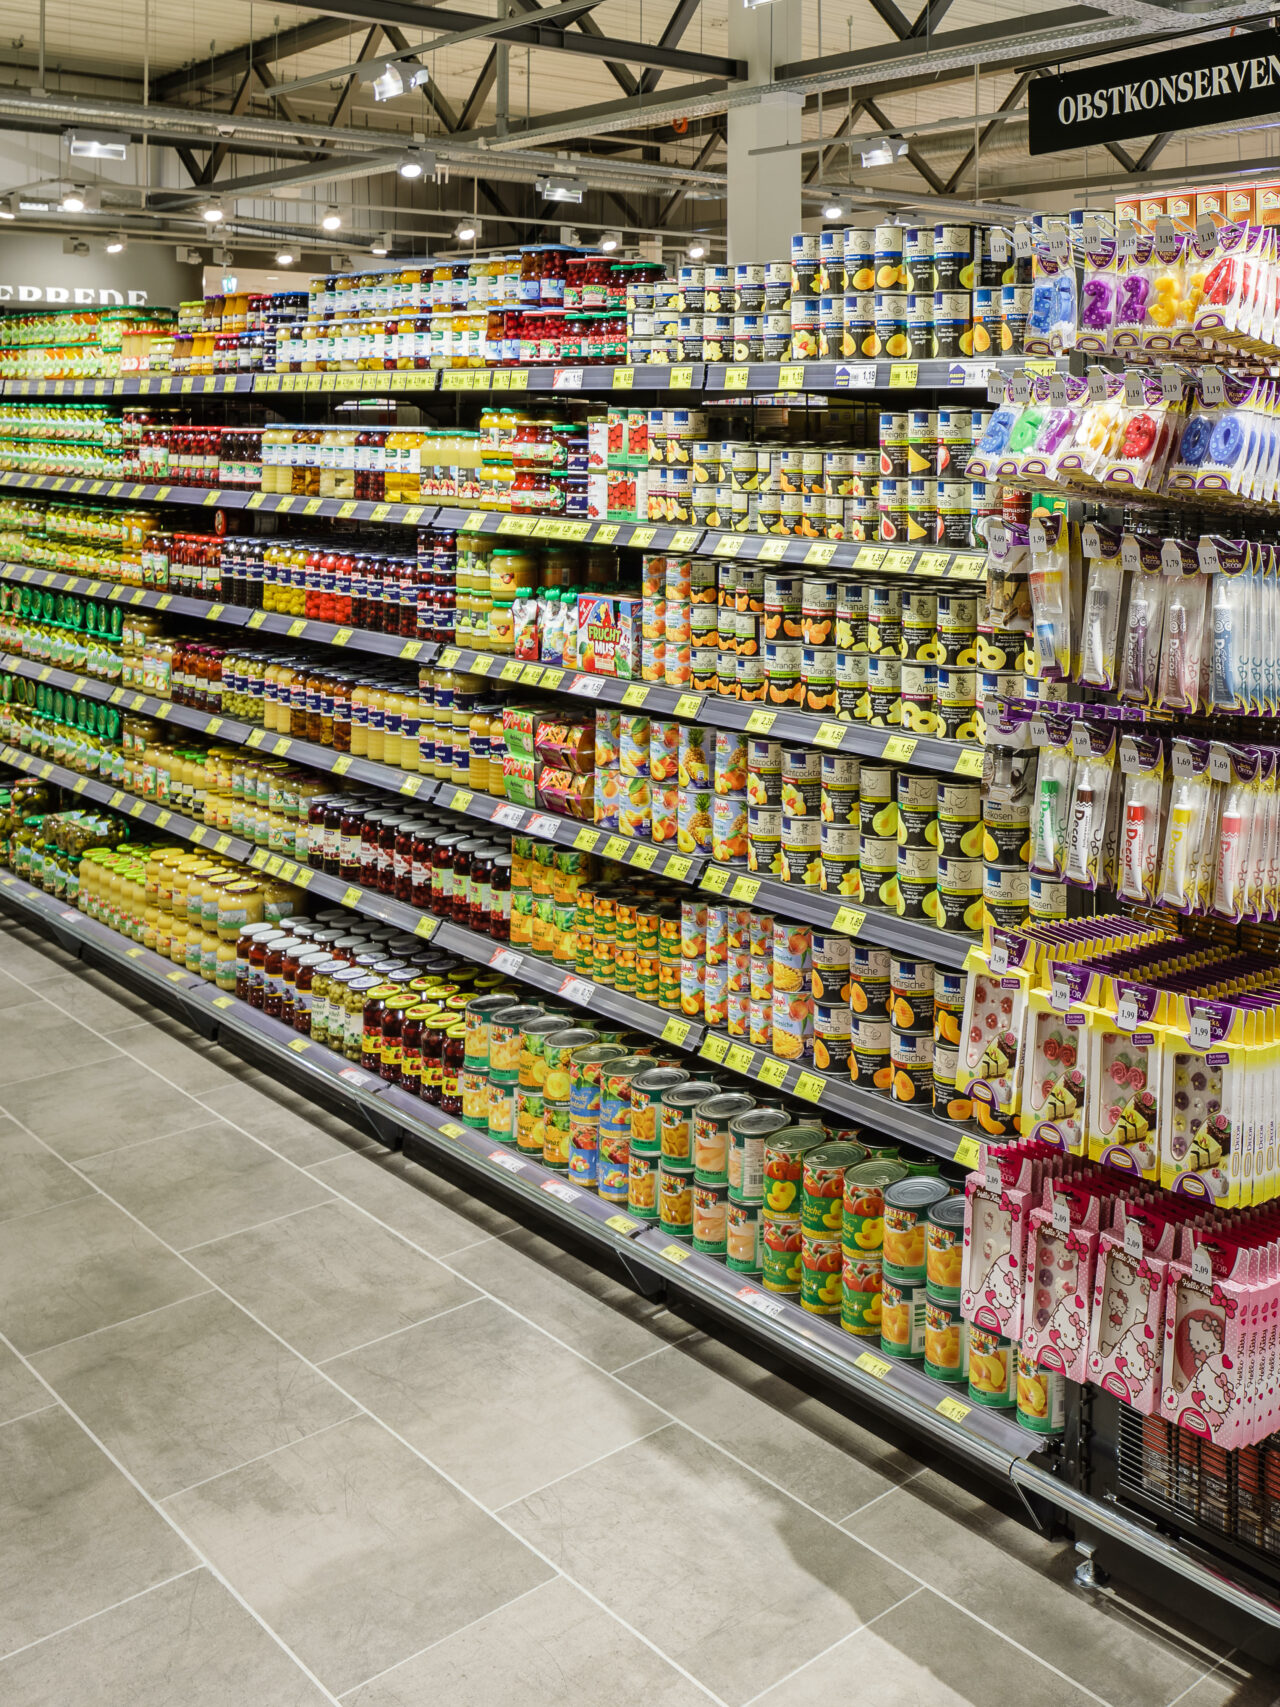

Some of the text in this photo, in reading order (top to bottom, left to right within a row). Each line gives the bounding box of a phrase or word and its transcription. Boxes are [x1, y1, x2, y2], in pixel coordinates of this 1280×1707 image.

[1085, 236, 1097, 244] 1,19
[1201, 231, 1215, 242] 1,19
[1051, 241, 1064, 249] 1,19
[1123, 239, 1135, 247] 1,19
[863, 371, 875, 381] 1,19
[905, 371, 917, 381] 1,19
[1015, 387, 1026, 395] 1,19
[1091, 385, 1103, 393] 1,19
[1164, 384, 1177, 393] 1,19
[1206, 386, 1220, 394] 1,19
[1052, 391, 1064, 399] 1,19
[1127, 390, 1139, 398] 1,19
[993, 535, 1004, 543] 4,69
[1033, 535, 1044, 543] 1,99
[1085, 538, 1097, 547] 1,69
[871, 554, 883, 562] 1,39
[1124, 554, 1137, 563] 1,79
[1203, 556, 1217, 565] 1,79
[933, 559, 946, 567] 1,49
[968, 562, 982, 570] 1,39
[1166, 560, 1179, 568] 1,79
[840, 603, 868, 611] Ananas
[588, 625, 622, 643] FRUCHT
[594, 642, 615, 656] MUS
[1033, 727, 1045, 735] 1,69
[831, 731, 843, 741] 1,59
[1075, 737, 1087, 745] 1,69
[900, 743, 913, 753] 1,59
[1122, 754, 1136, 763] 1,69
[1176, 757, 1190, 766] 1,69
[1214, 760, 1228, 769] 1,69
[1125, 828, 1138, 870] Decor
[850, 915, 864, 926] 1,89
[994, 955, 1006, 964] 1,99
[893, 977, 925, 989] Pfirsiche
[1055, 990, 1068, 1000] 1,99
[1121, 1009, 1135, 1020] 1,99
[1194, 1027, 1209, 1036] 1,99
[1054, 1212, 1067, 1224] 2,09
[1127, 1237, 1141, 1249] 2,09
[1194, 1263, 1209, 1275] 2,09
